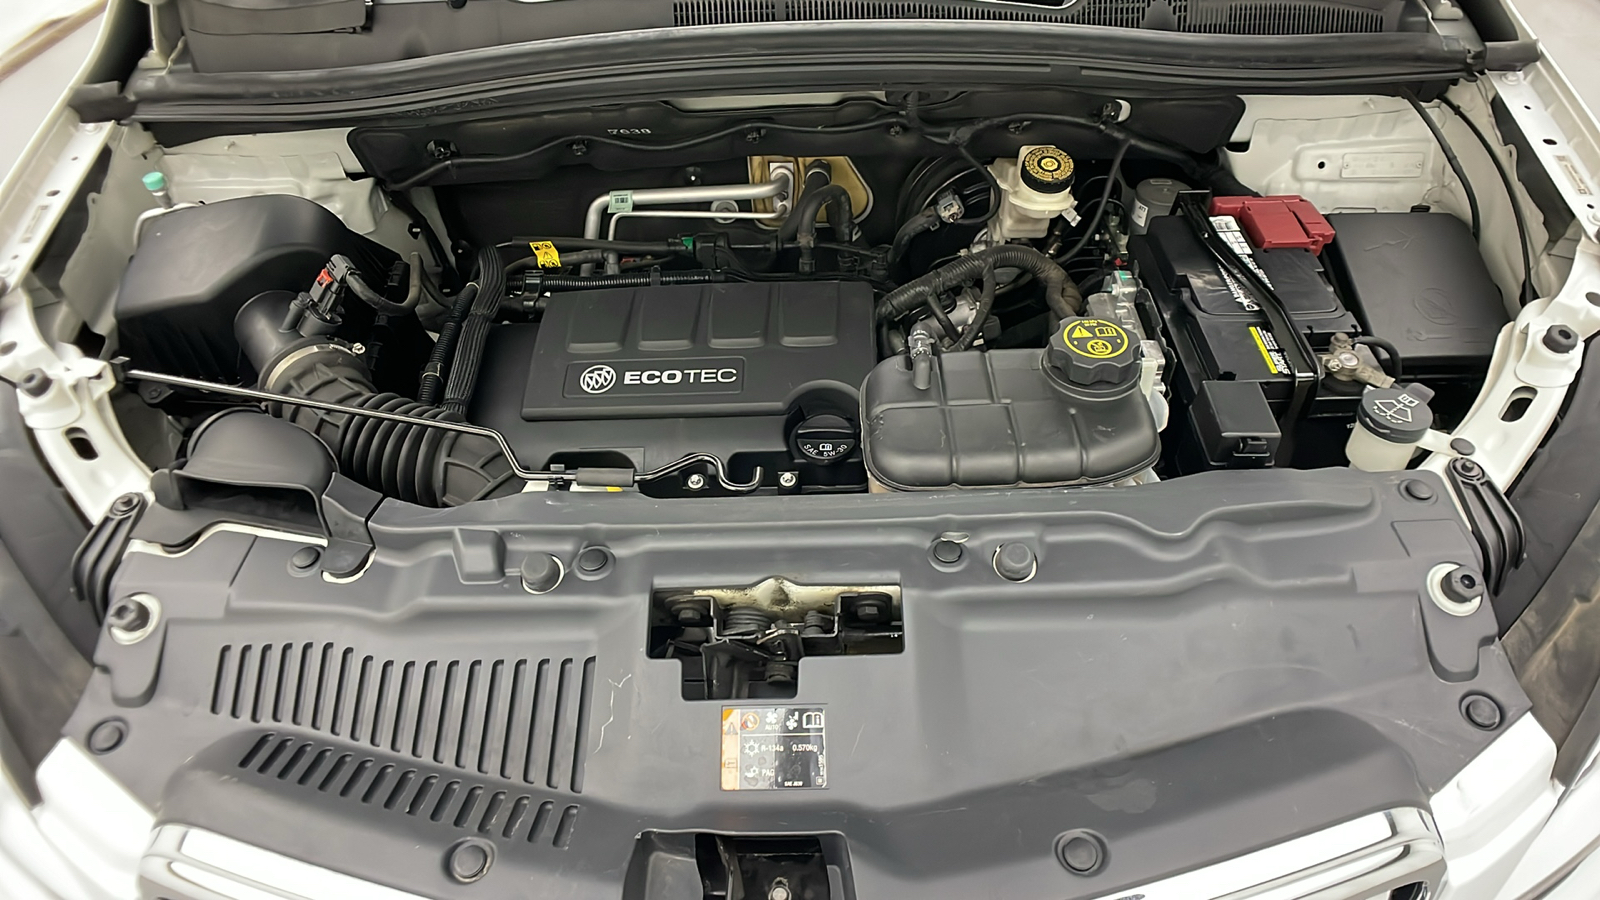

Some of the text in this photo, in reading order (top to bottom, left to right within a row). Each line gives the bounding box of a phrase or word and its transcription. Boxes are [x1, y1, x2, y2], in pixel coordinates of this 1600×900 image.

[623, 368, 737, 385] ECOTEC
[803, 444, 848, 457] SAE 5W-30
[761, 744, 785, 752] R-134a
